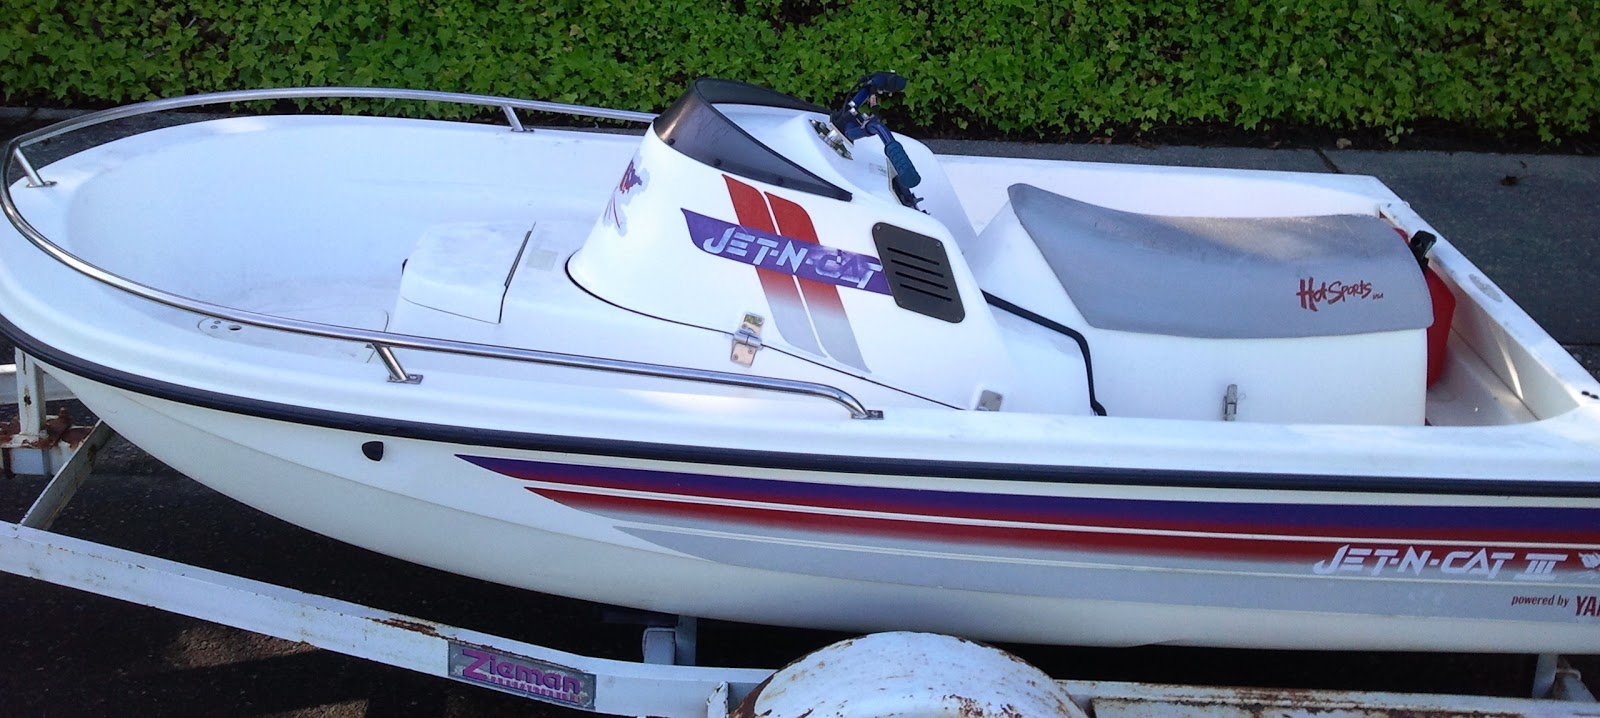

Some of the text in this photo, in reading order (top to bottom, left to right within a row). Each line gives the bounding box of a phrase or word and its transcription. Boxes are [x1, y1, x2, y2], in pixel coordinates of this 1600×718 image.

[1513, 553, 1568, 580] III
[1511, 594, 1600, 616] powered by YA
[462, 649, 580, 695] Zieman
